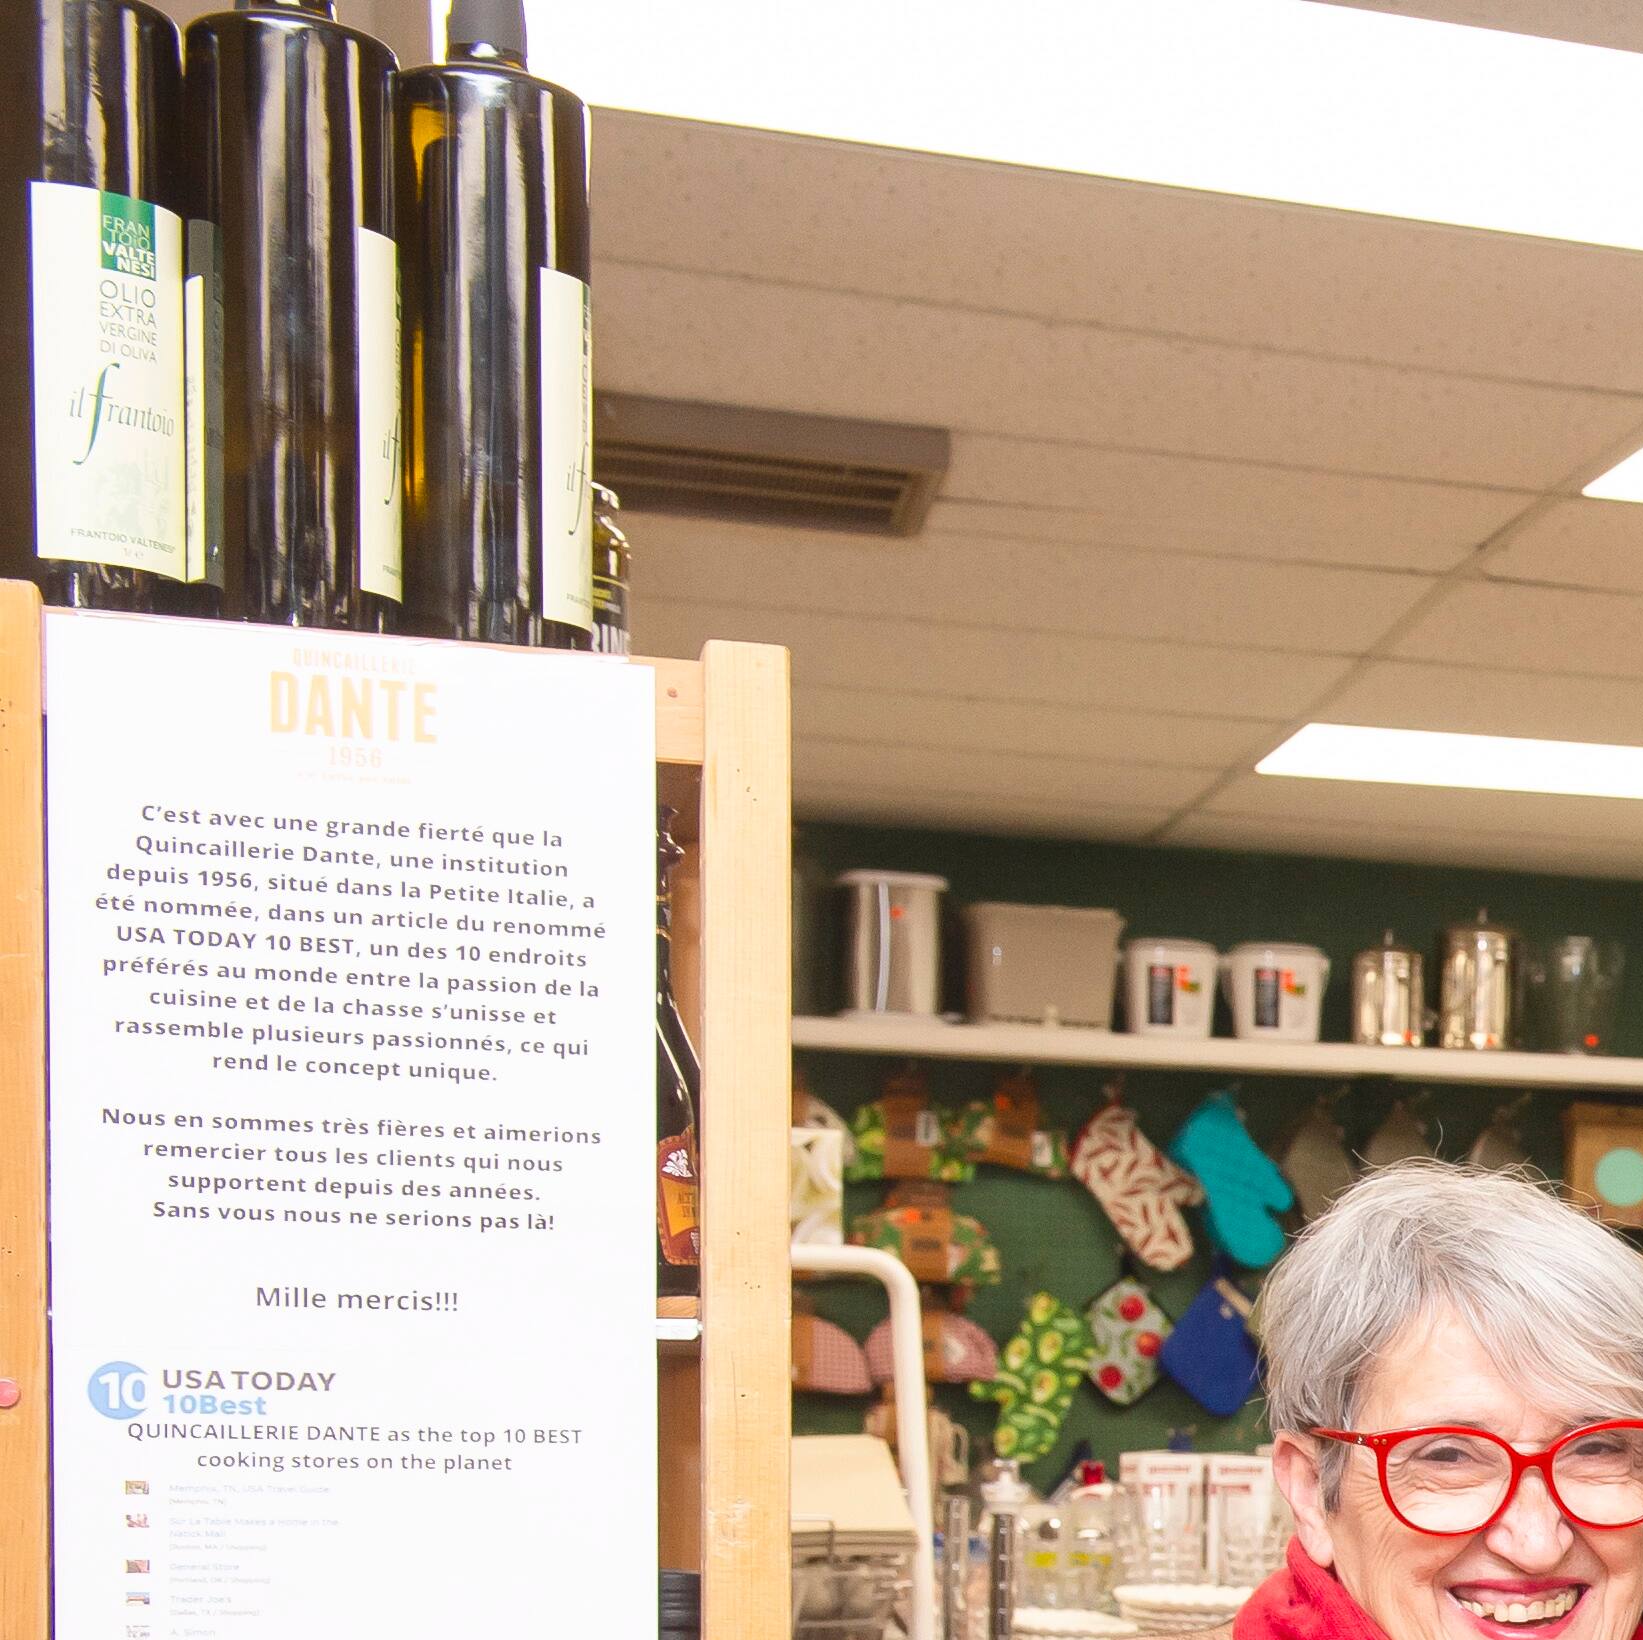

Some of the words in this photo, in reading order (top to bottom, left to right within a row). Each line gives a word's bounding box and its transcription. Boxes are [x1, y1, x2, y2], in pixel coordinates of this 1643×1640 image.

[103, 214, 149, 237] FRAN
[102, 240, 155, 265] VALTE
[117, 256, 156, 280] NESI
[100, 279, 156, 308] OLIO
[100, 301, 157, 330] EXTRA
[99, 321, 158, 347] VERGINE
[100, 340, 116, 354] DI
[120, 343, 158, 363] OLIVA
[269, 670, 438, 744] DANTE
[327, 743, 384, 770] 1956
[143, 806, 200, 824] C'est
[210, 814, 264, 828] avec
[274, 818, 317, 831] une
[326, 821, 409, 837] grande
[419, 823, 483, 842] fierté
[493, 832, 534, 848] que
[544, 831, 561, 847] la
[137, 836, 294, 860] Quincaillerie
[304, 847, 380, 868] Dante,
[391, 856, 433, 869] une
[443, 854, 567, 876] institution
[118, 926, 165, 943] USA
[173, 930, 256, 948] TODAY
[266, 936, 290, 950] 10
[301, 937, 360, 957] BEST,
[371, 944, 398, 956] un
[408, 943, 446, 959] des
[457, 946, 480, 961] 10
[489, 948, 586, 966] endroits
[103, 1109, 165, 1126] Nous
[175, 1115, 202, 1127] en
[213, 1117, 313, 1132] sommes
[323, 1118, 368, 1134] très
[378, 1120, 444, 1137] fières
[454, 1126, 475, 1139] et
[485, 1125, 600, 1144] aimerions
[154, 1202, 209, 1218] Sans
[218, 1208, 274, 1221] vous
[285, 1210, 340, 1223] nous
[350, 1213, 377, 1224] ne
[386, 1210, 471, 1227] serions
[481, 1217, 519, 1232] pas
[528, 1214, 553, 1230] là!
[257, 1287, 325, 1308] Mille
[338, 1291, 457, 1311] mercis!!!
[164, 1370, 225, 1389] USA
[232, 1371, 335, 1391] TODAY
[163, 1394, 267, 1415] 10Best
[128, 1423, 298, 1441] QUINCAILLERIE
[308, 1427, 379, 1441] DANTE
[389, 1431, 409, 1441] as
[419, 1427, 452, 1442] the
[461, 1430, 494, 1446] top
[504, 1429, 525, 1443] 10
[535, 1430, 581, 1443] BEST
[198, 1452, 284, 1472] cooking
[292, 1456, 358, 1468] stores
[368, 1458, 392, 1468] on
[401, 1454, 435, 1469] the
[445, 1455, 511, 1473] planet
